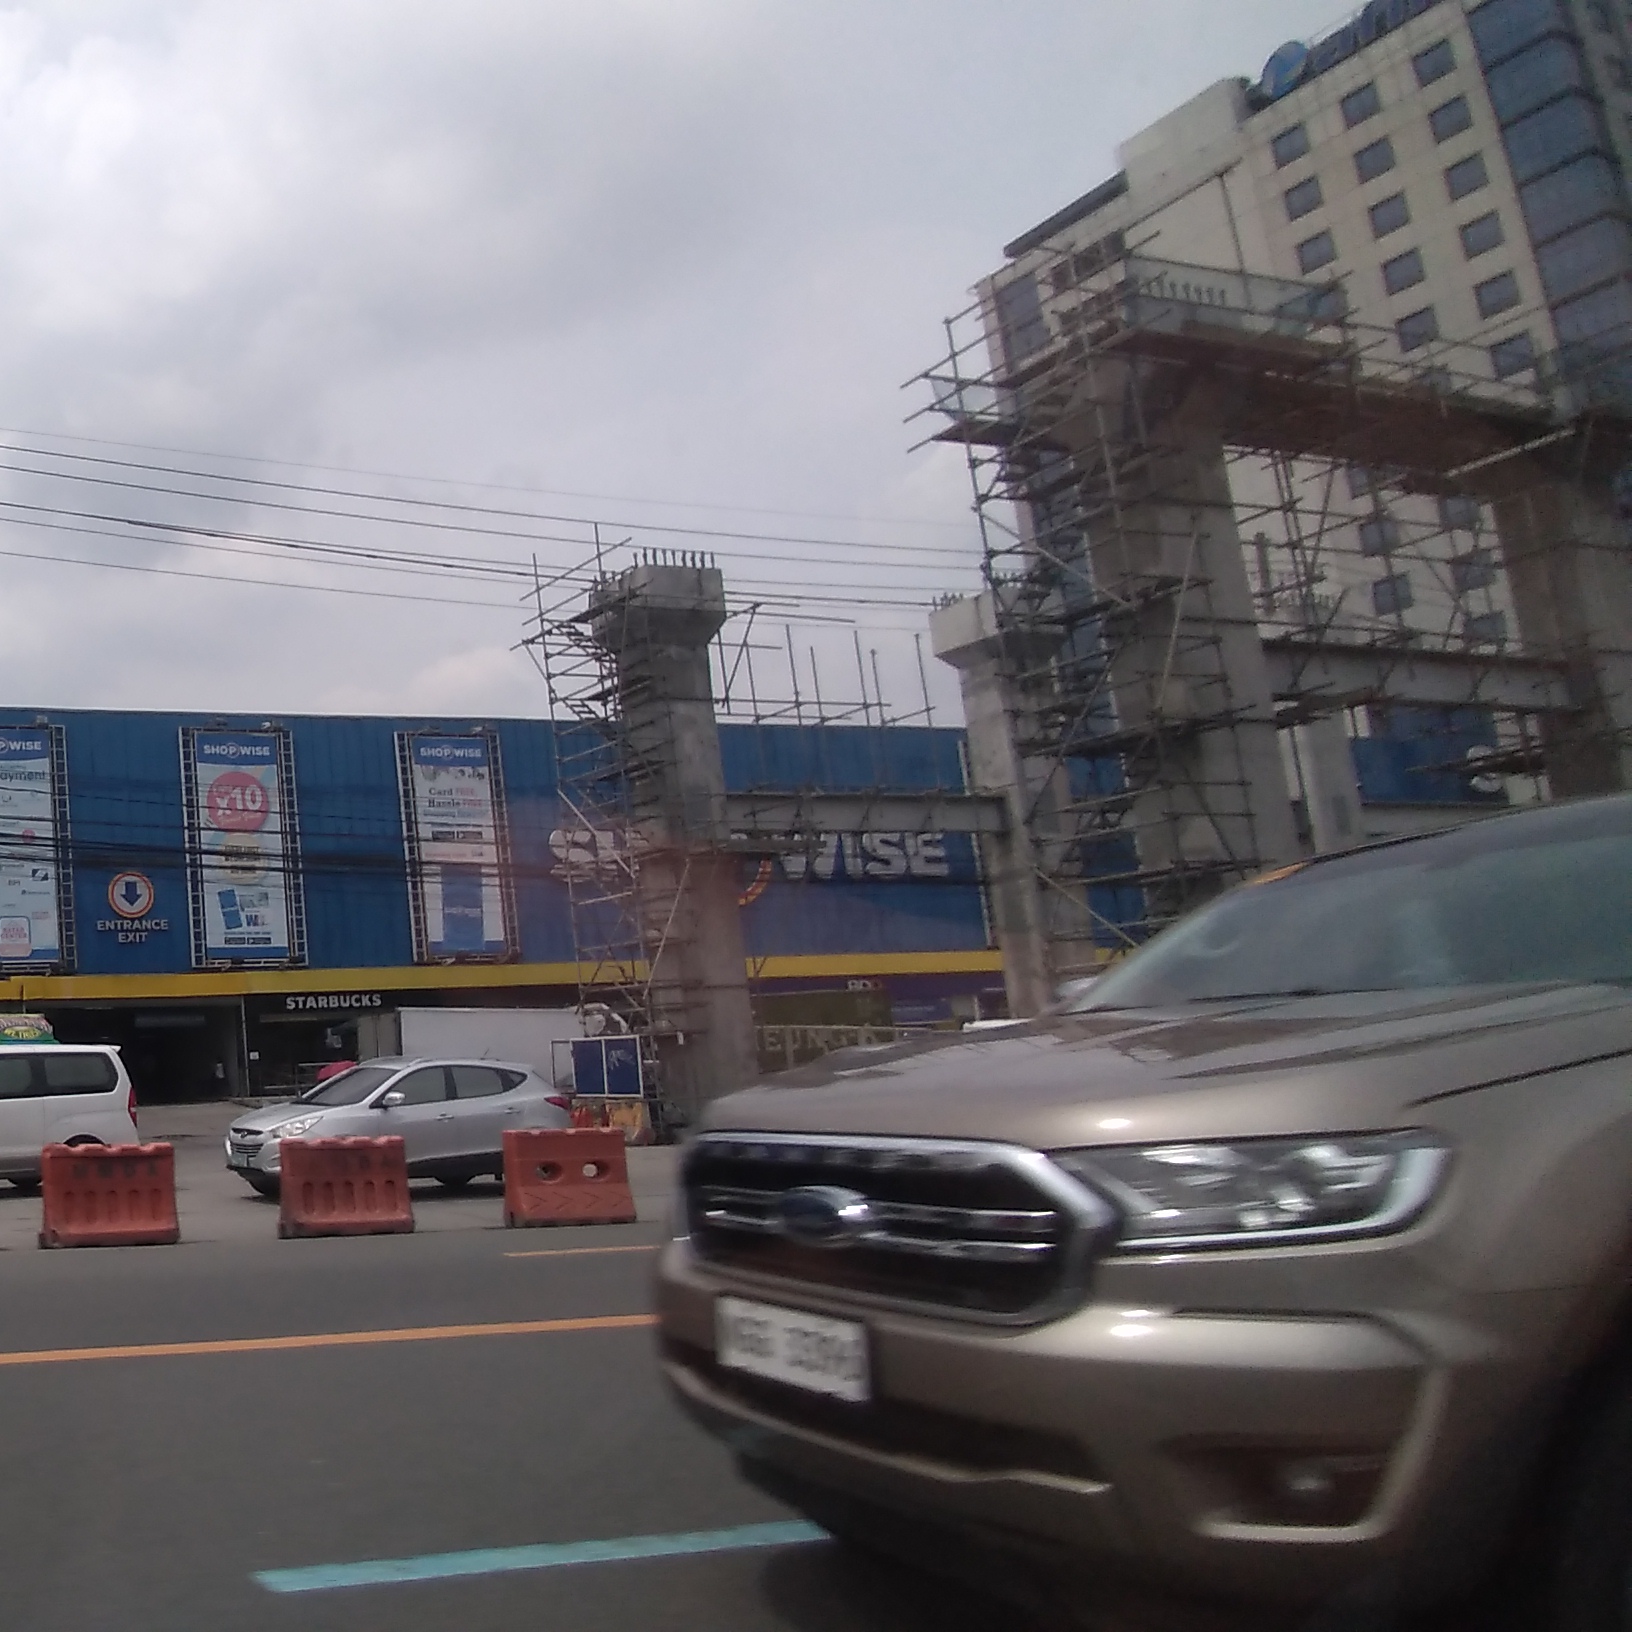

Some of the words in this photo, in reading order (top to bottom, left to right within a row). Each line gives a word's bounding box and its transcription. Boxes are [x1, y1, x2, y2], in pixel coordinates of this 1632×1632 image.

[96, 919, 169, 931] ENTRANCE
[117, 931, 148, 944] EXIT
[285, 993, 383, 1010] STARBUCKS
